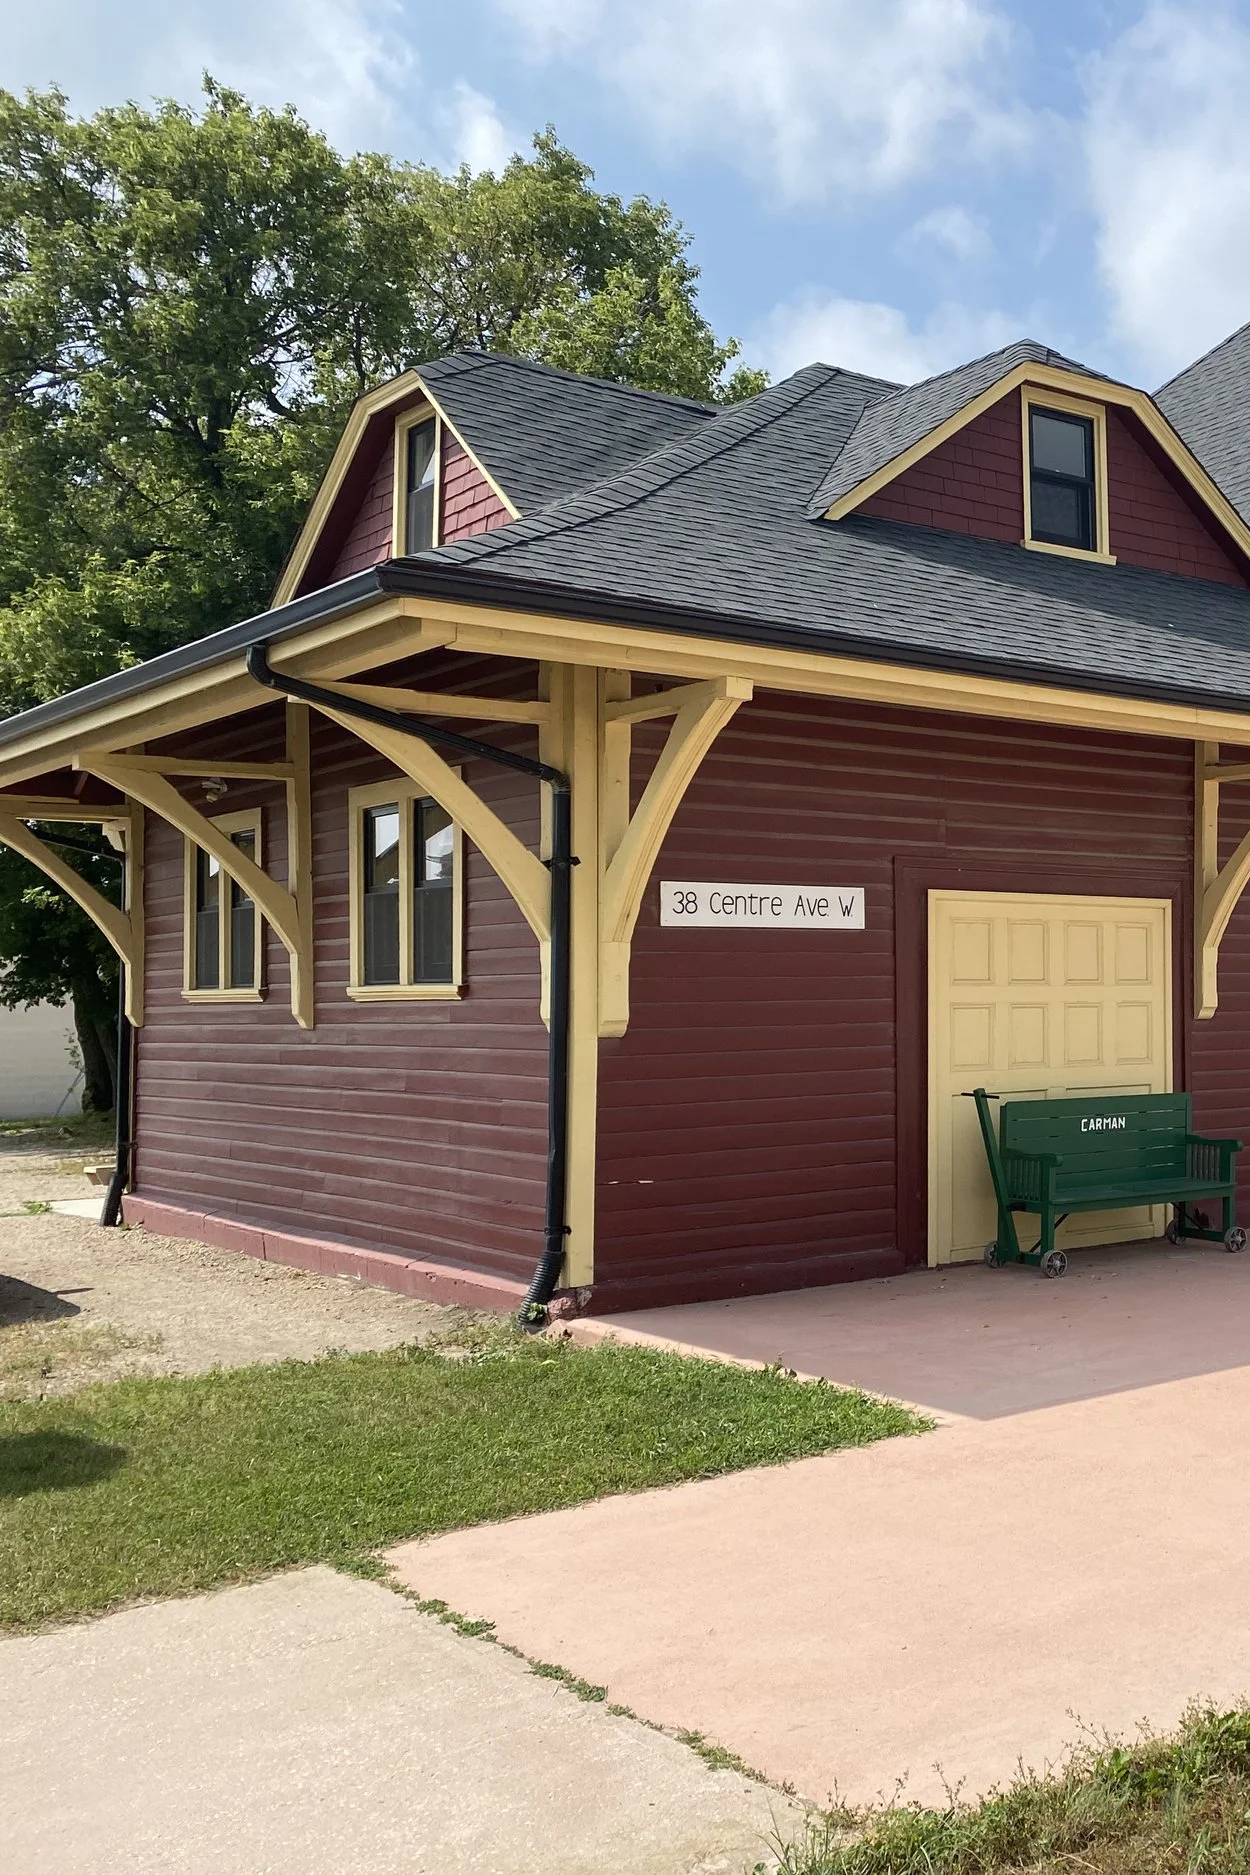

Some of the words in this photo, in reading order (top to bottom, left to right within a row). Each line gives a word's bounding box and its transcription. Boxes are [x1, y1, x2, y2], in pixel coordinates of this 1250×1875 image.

[672, 891, 698, 914] 38
[709, 892, 783, 916] Centre
[1081, 1116, 1126, 1132] CARMAN
